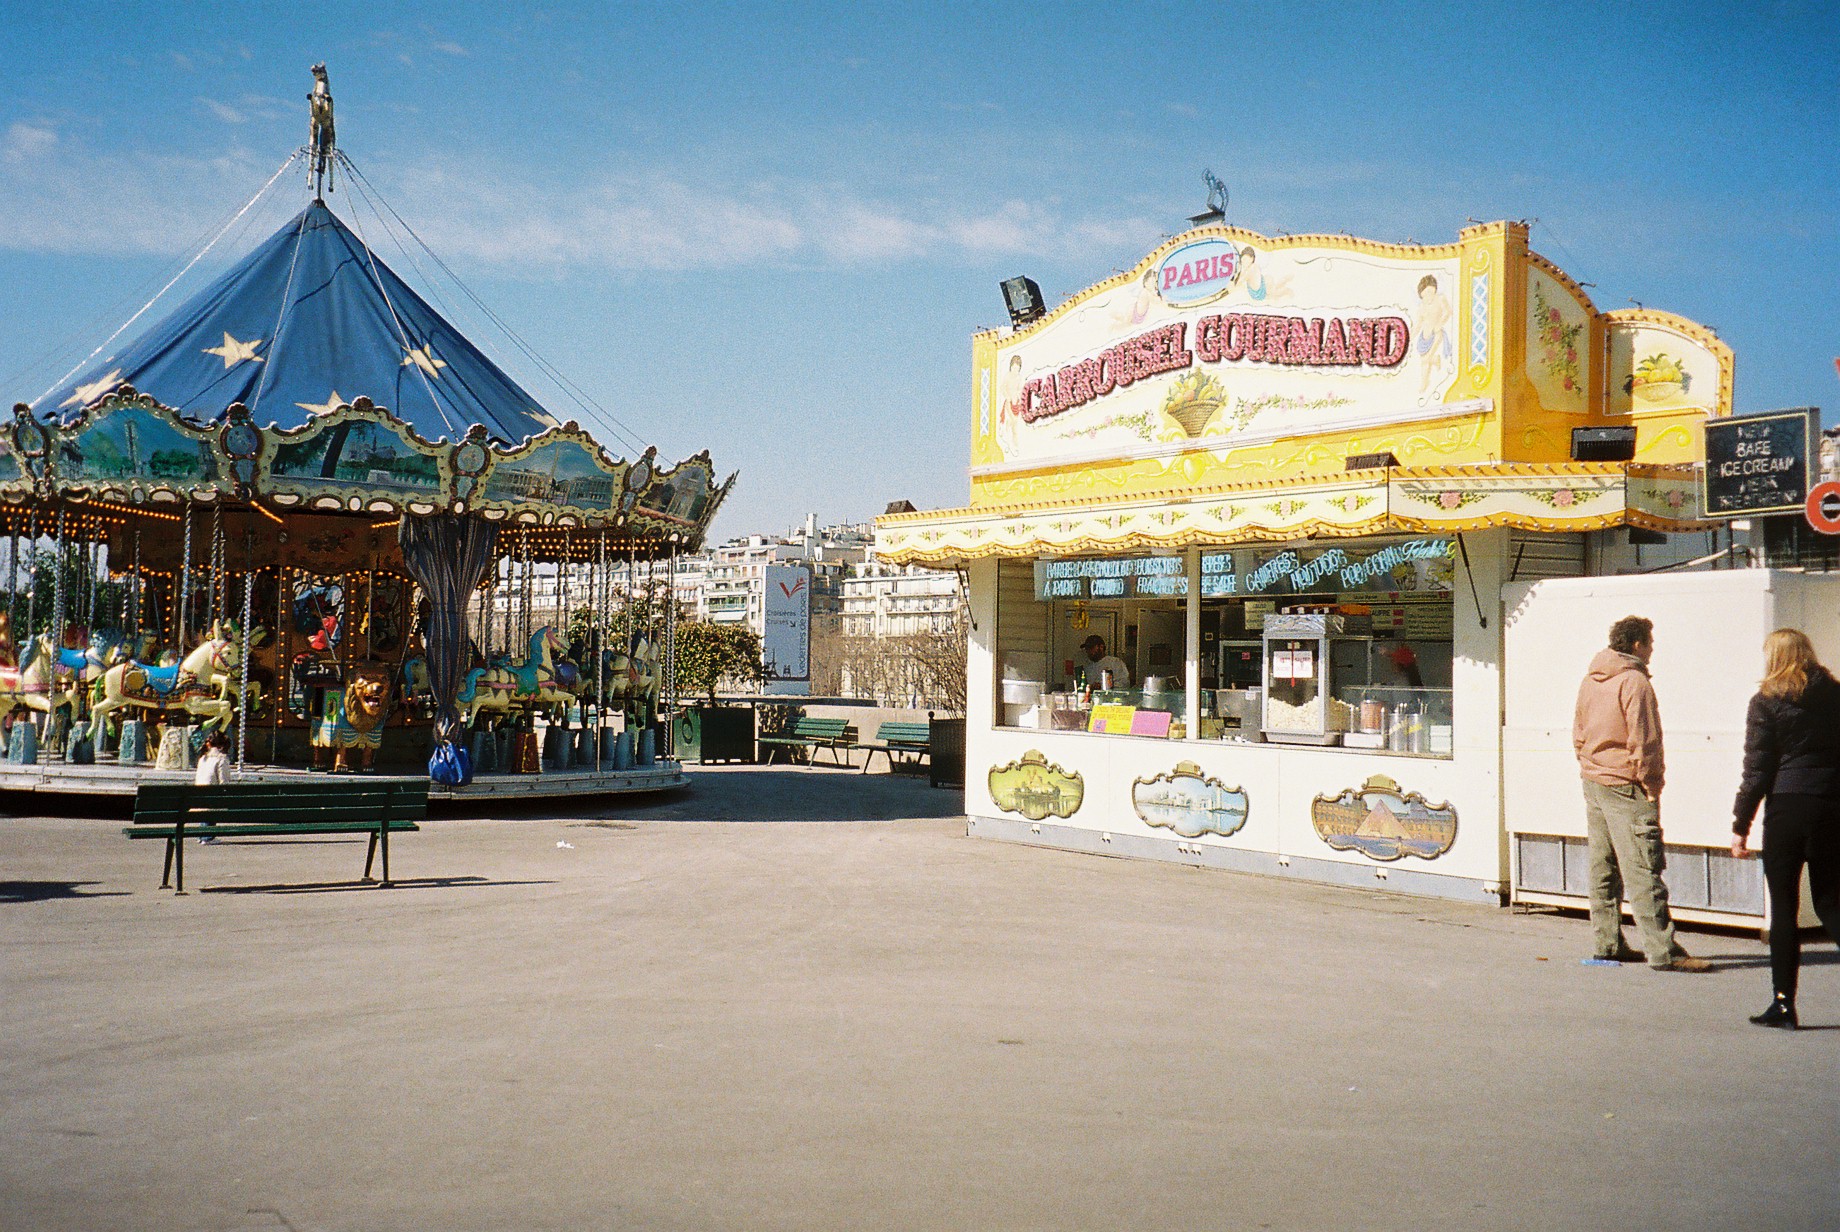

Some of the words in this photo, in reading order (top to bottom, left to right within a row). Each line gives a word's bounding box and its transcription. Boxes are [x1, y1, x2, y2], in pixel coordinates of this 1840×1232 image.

[1162, 251, 1236, 291] PARIS
[1020, 321, 1194, 423] CARROUSEL
[1194, 311, 1411, 369] GOURMAND
[1720, 460, 1742, 478] ICE
[1743, 456, 1795, 475] CREAM
